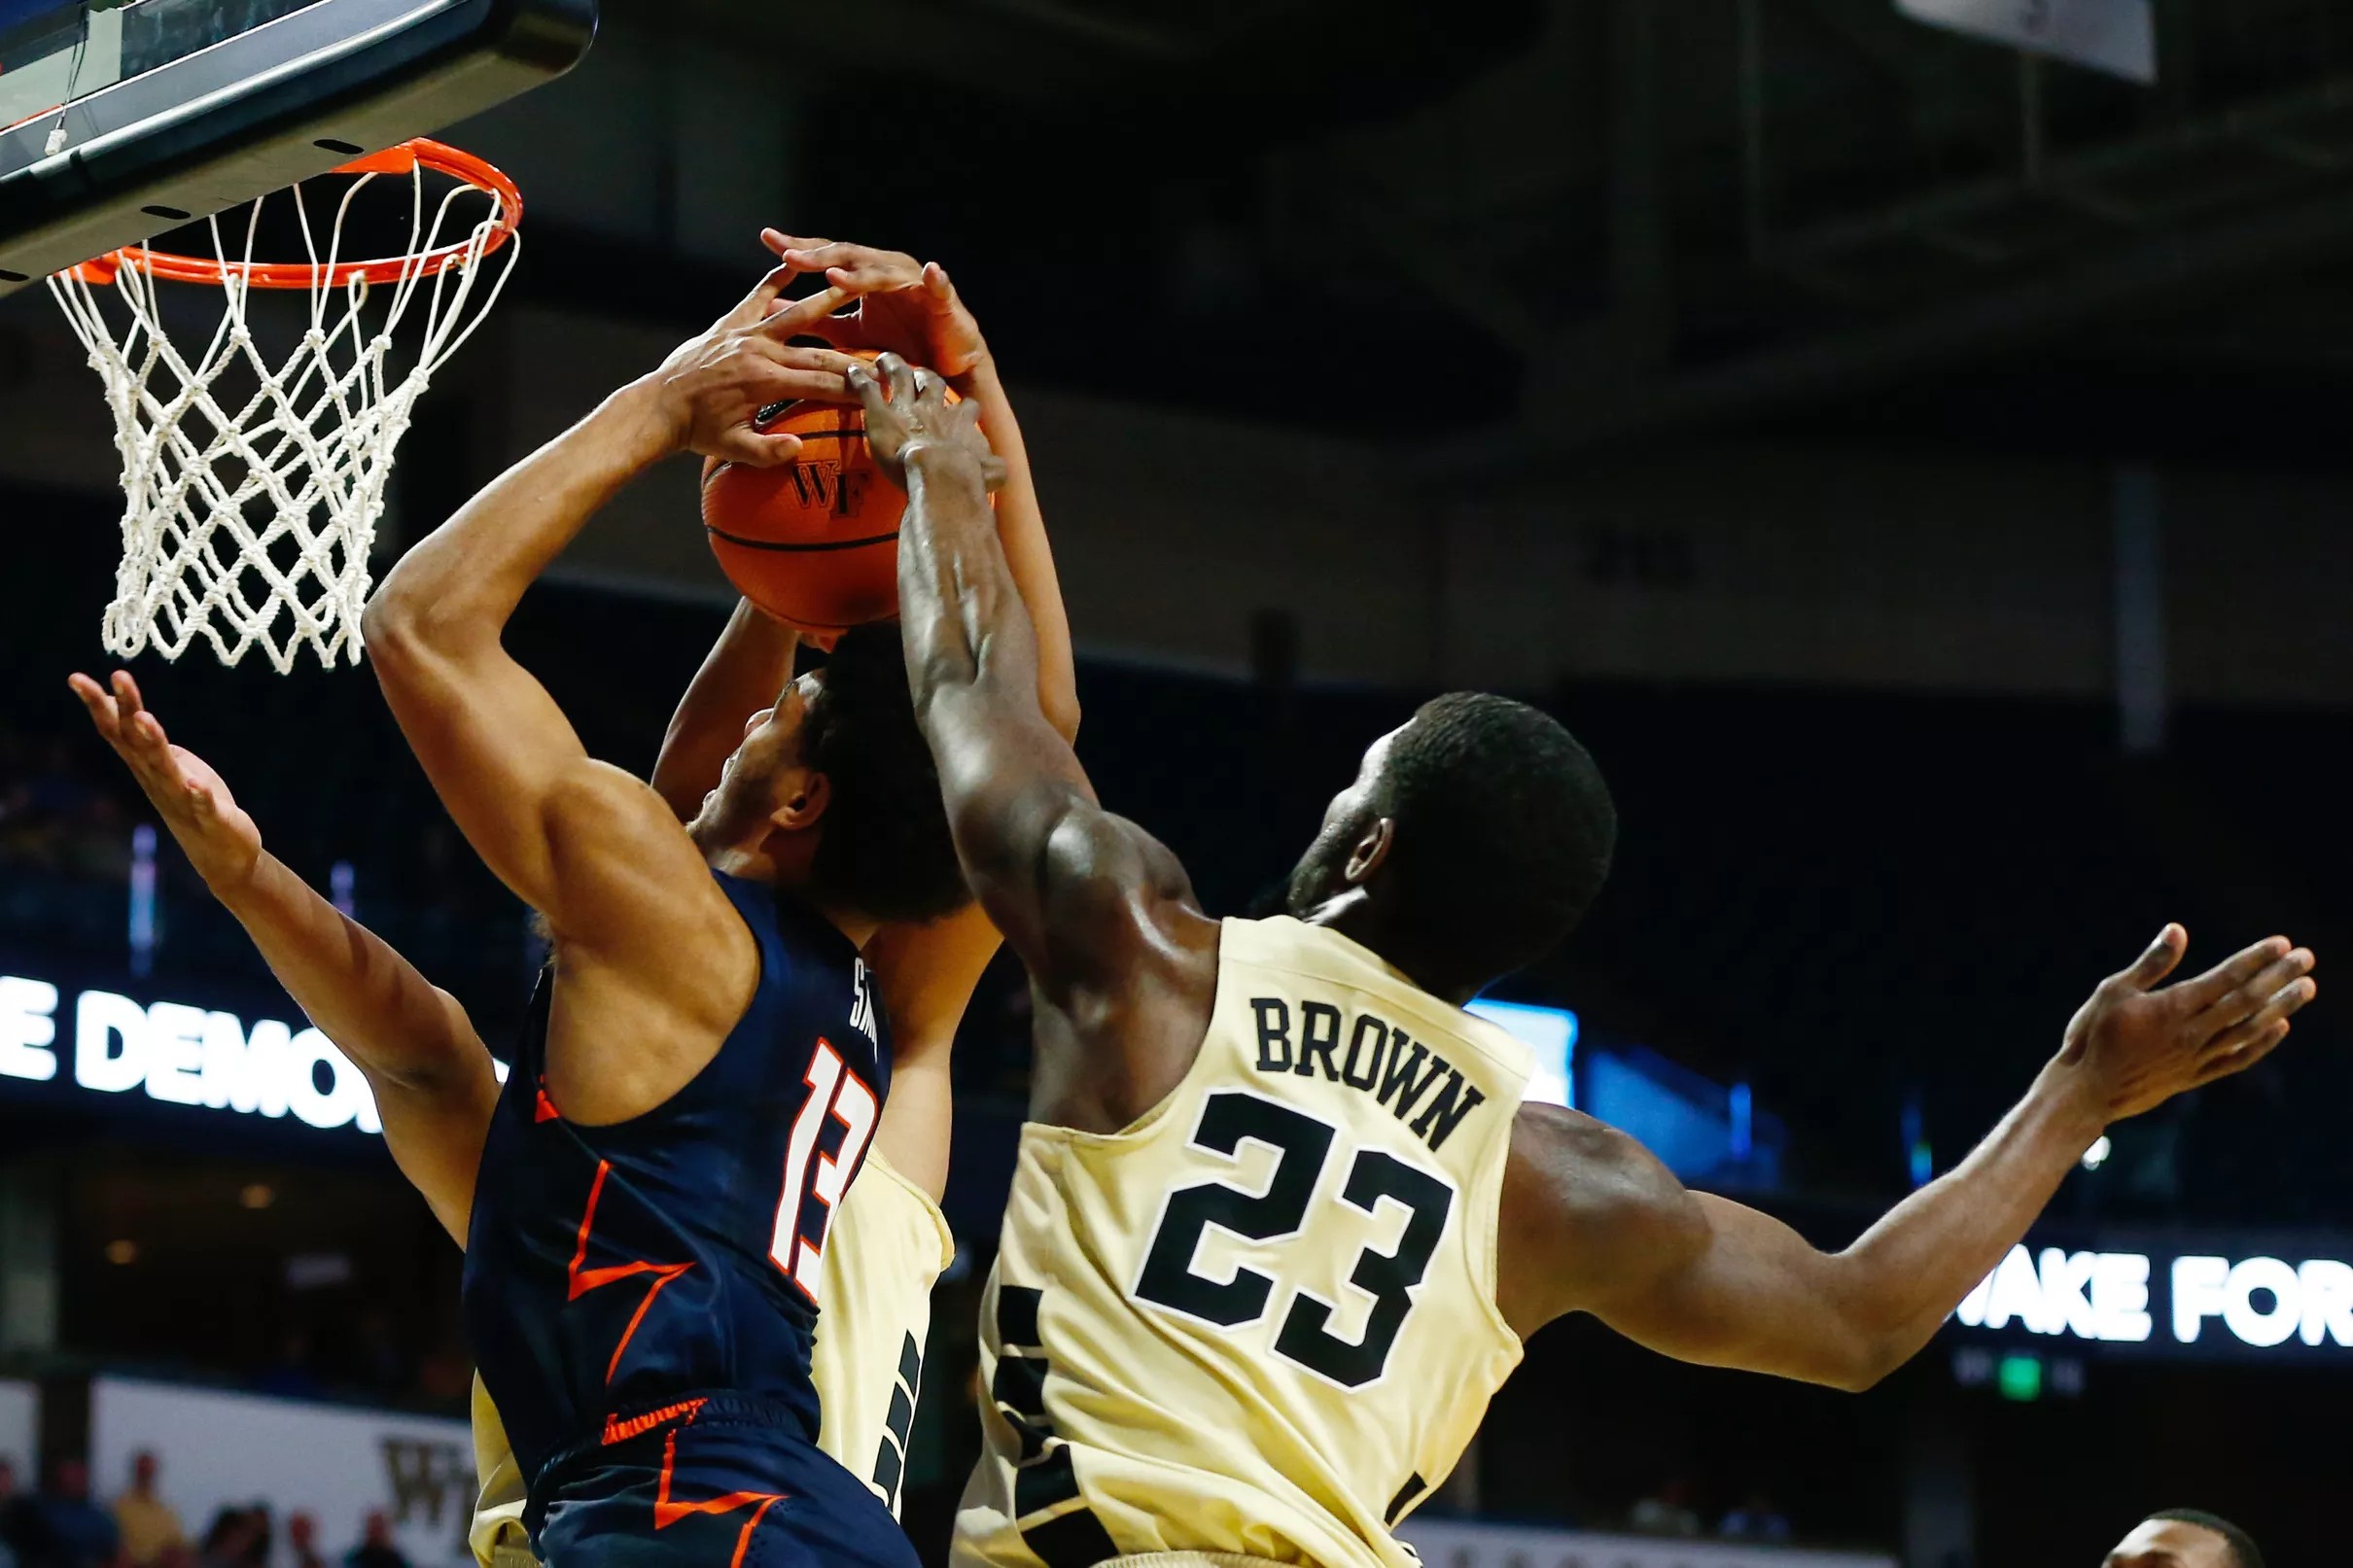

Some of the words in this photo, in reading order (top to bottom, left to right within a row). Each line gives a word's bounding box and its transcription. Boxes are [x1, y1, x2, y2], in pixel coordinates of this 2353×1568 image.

[791, 460, 872, 519] WF
[76, 990, 385, 1134] DEMO
[1250, 998, 1486, 1153] BROWN
[768, 1036, 880, 1305] 13
[1127, 1088, 1460, 1394] 23
